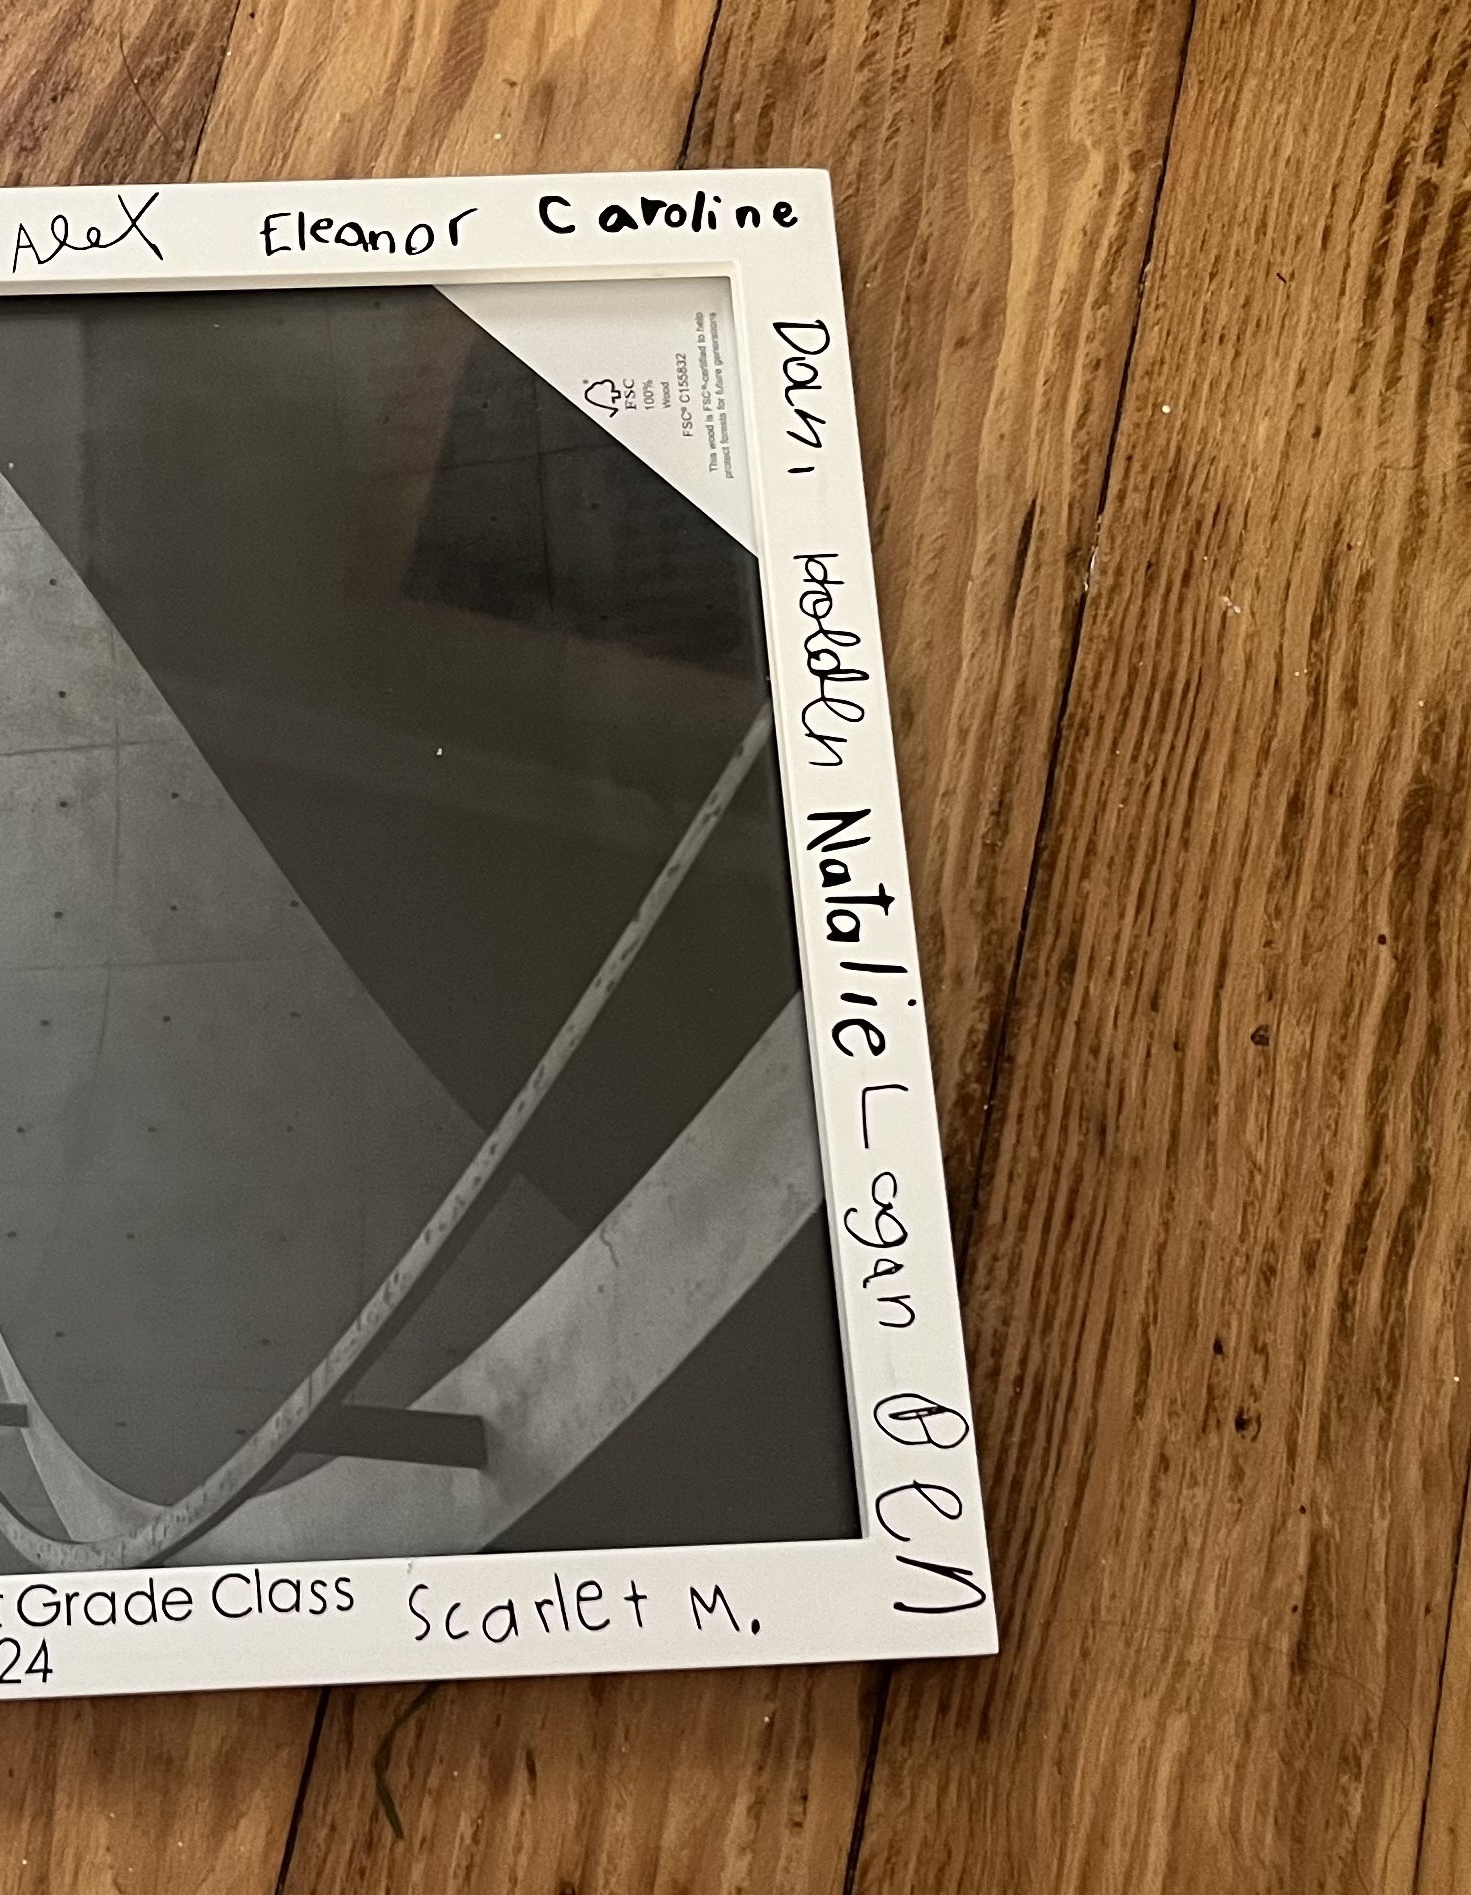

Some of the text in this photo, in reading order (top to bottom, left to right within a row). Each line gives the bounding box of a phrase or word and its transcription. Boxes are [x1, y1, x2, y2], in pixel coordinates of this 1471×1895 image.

[258, 206, 479, 258] Eleanor
[537, 189, 799, 236] Caroline
[623, 378, 637, 410] FSC
[642, 379, 655, 410] 100%
[660, 381, 672, 409] Wood
[805, 807, 918, 1058] Natalie
[15, 1576, 194, 1628] Grade
[210, 1567, 355, 1620] Class
[407, 1571, 762, 1645] Scarlet M.
